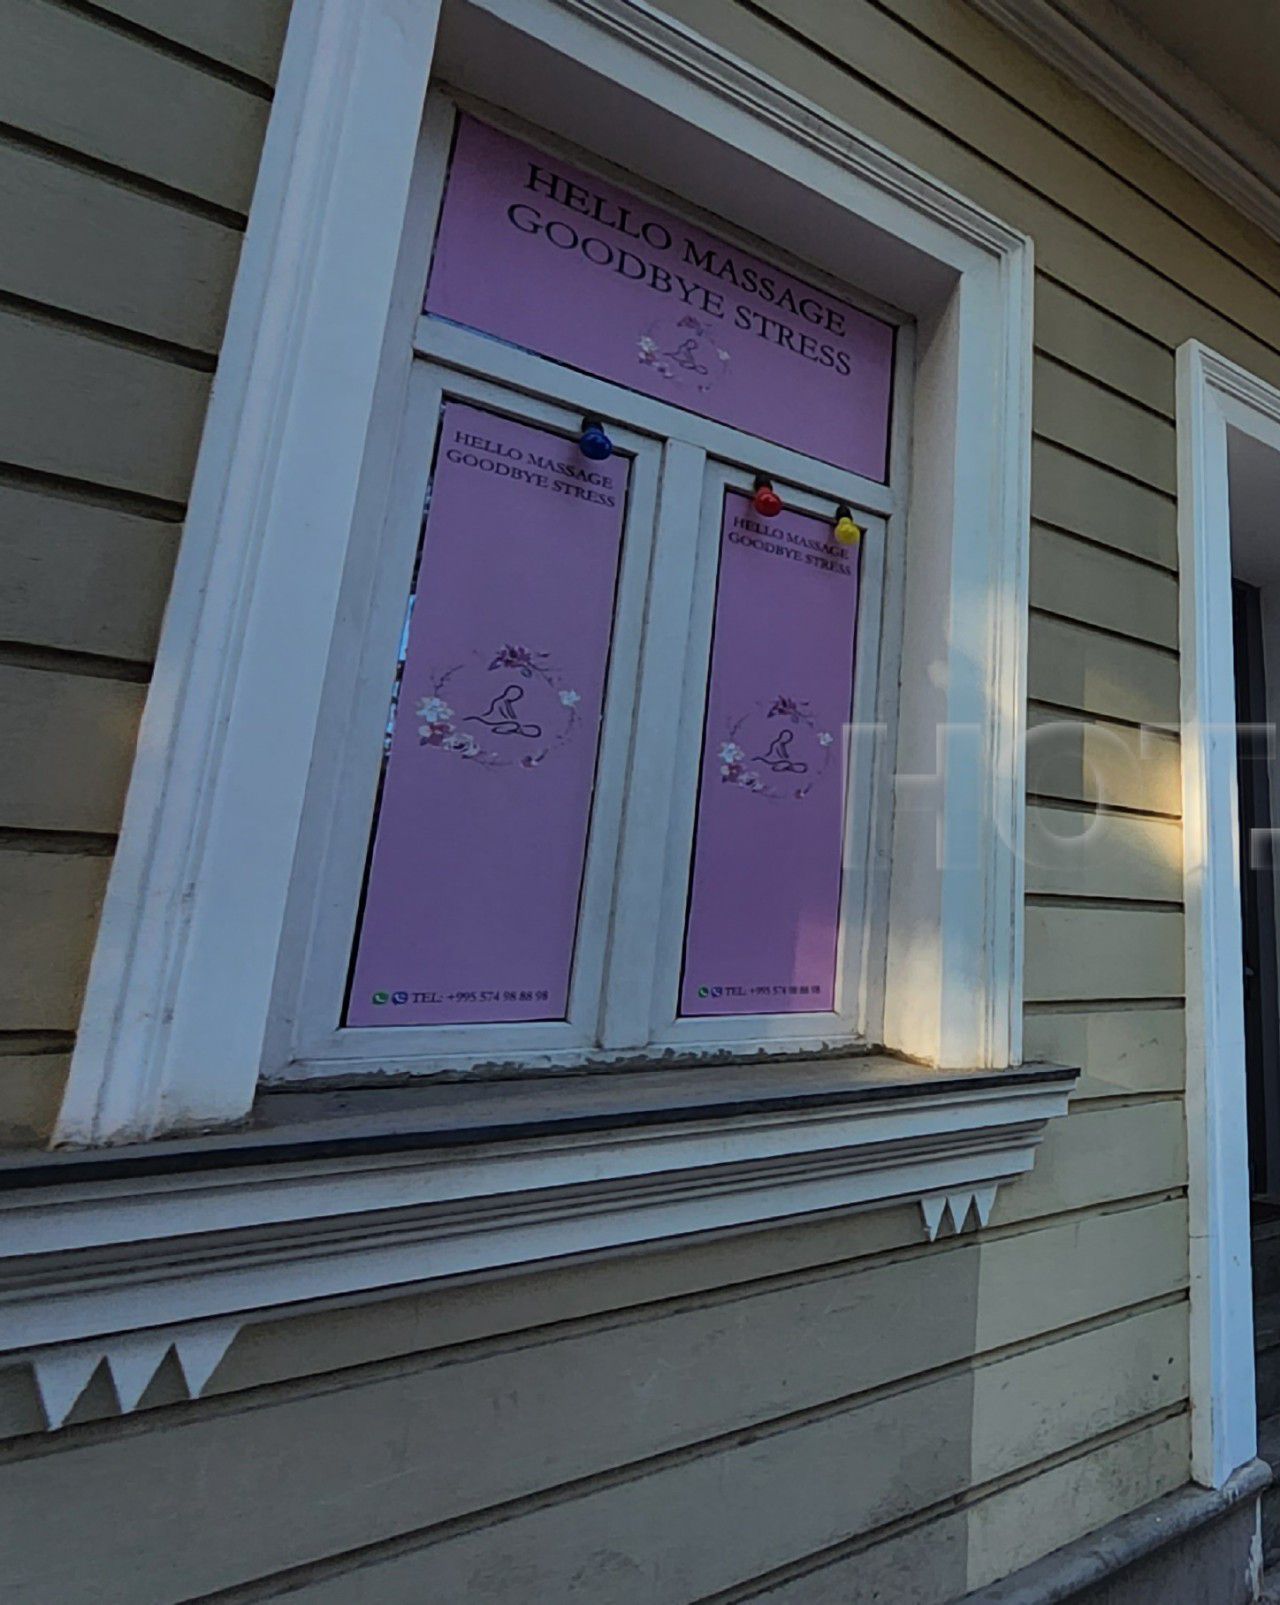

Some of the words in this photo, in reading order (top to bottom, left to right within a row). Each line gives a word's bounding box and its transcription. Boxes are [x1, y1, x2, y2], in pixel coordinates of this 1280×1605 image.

[524, 163, 672, 250] HELLO
[682, 238, 846, 337] MASSAGE
[507, 203, 724, 319] GOODBYE
[733, 304, 852, 377] STRESS
[446, 449, 549, 488] GOODBYE
[551, 479, 616, 508] STRESS
[455, 431, 523, 460] HELLO
[528, 453, 613, 489] MASSAGE
[728, 531, 802, 561] GOODBYE
[805, 555, 852, 576] STRESS
[733, 516, 784, 540] HELLO
[787, 532, 849, 560] MASSAGE
[412, 991, 443, 1004] TEL:
[447, 990, 477, 1002] +995
